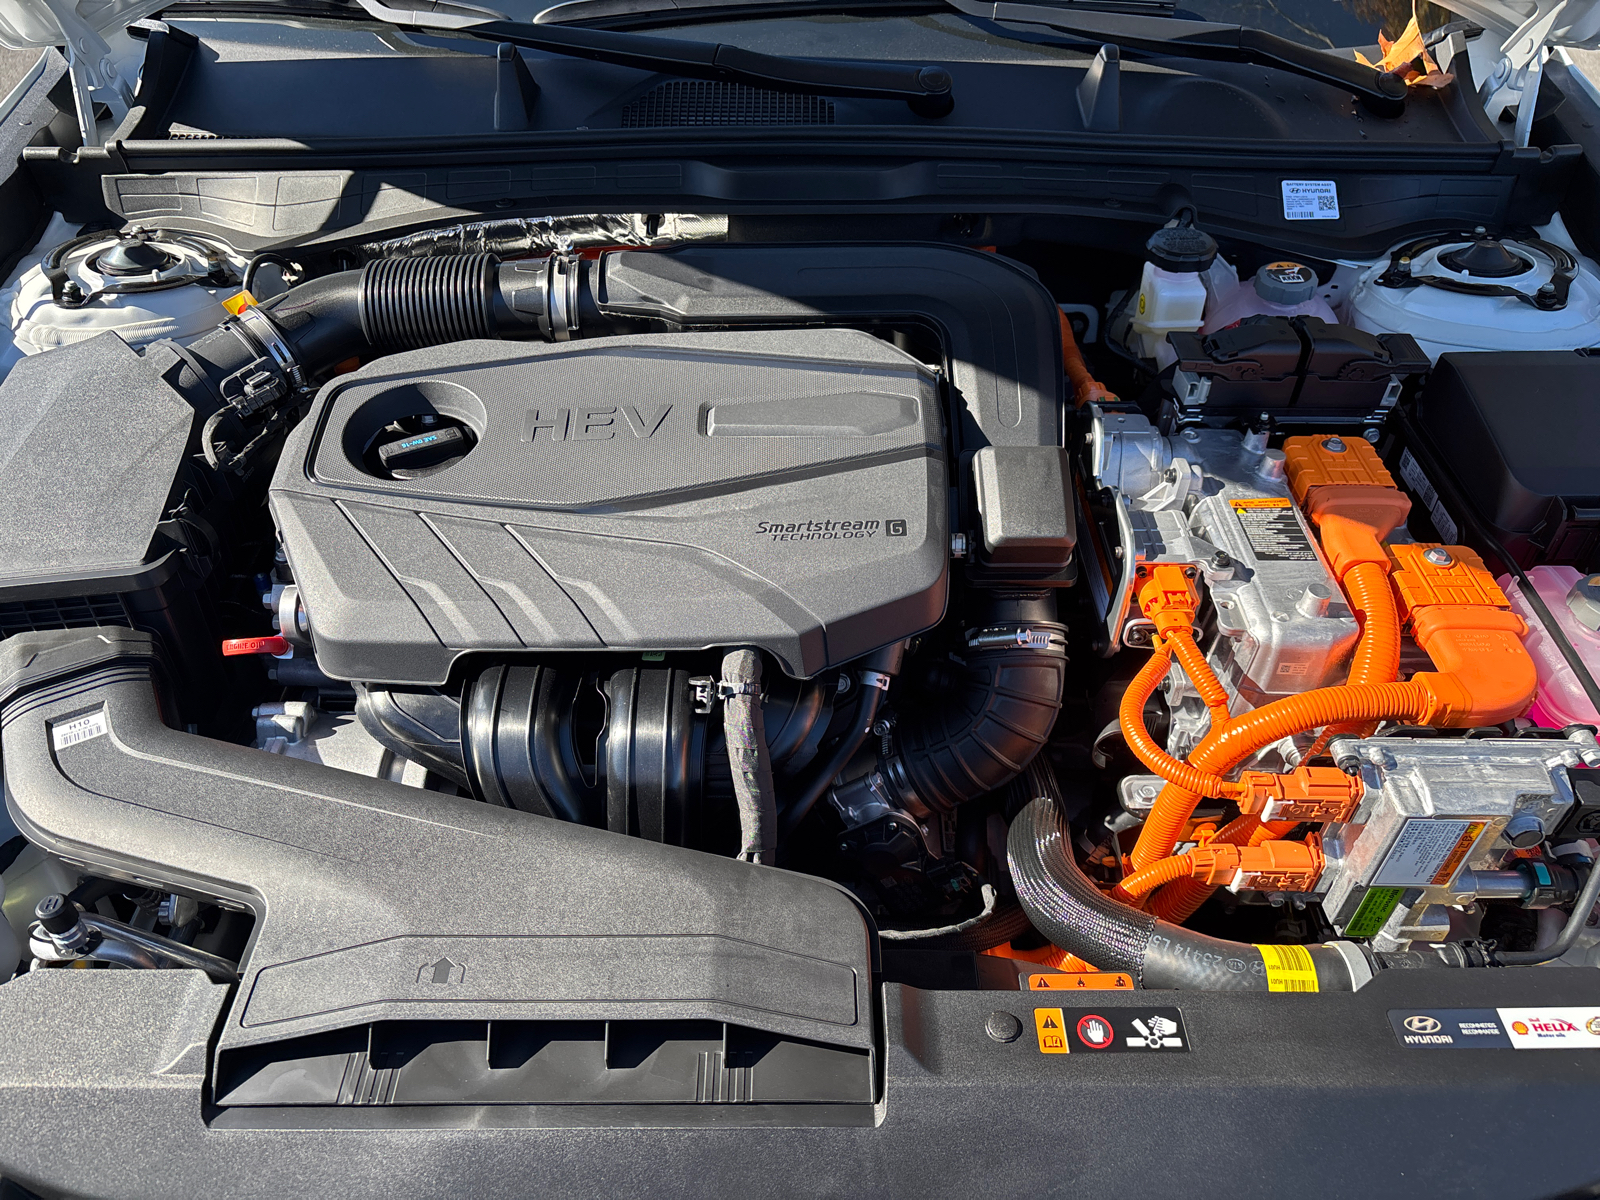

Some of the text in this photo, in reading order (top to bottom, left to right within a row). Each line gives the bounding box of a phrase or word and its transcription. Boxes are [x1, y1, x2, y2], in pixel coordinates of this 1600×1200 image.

[519, 404, 673, 442] HEV
[401, 434, 438, 449] SAE 0W-16
[755, 519, 879, 534] Smartstream
[770, 530, 877, 542] TECHNOLOGY
[68, 718, 90, 730] H10
[1173, 943, 1223, 969] 23414
[1532, 1022, 1577, 1032] HELIX
[1404, 1035, 1454, 1044] HYUNDAI
